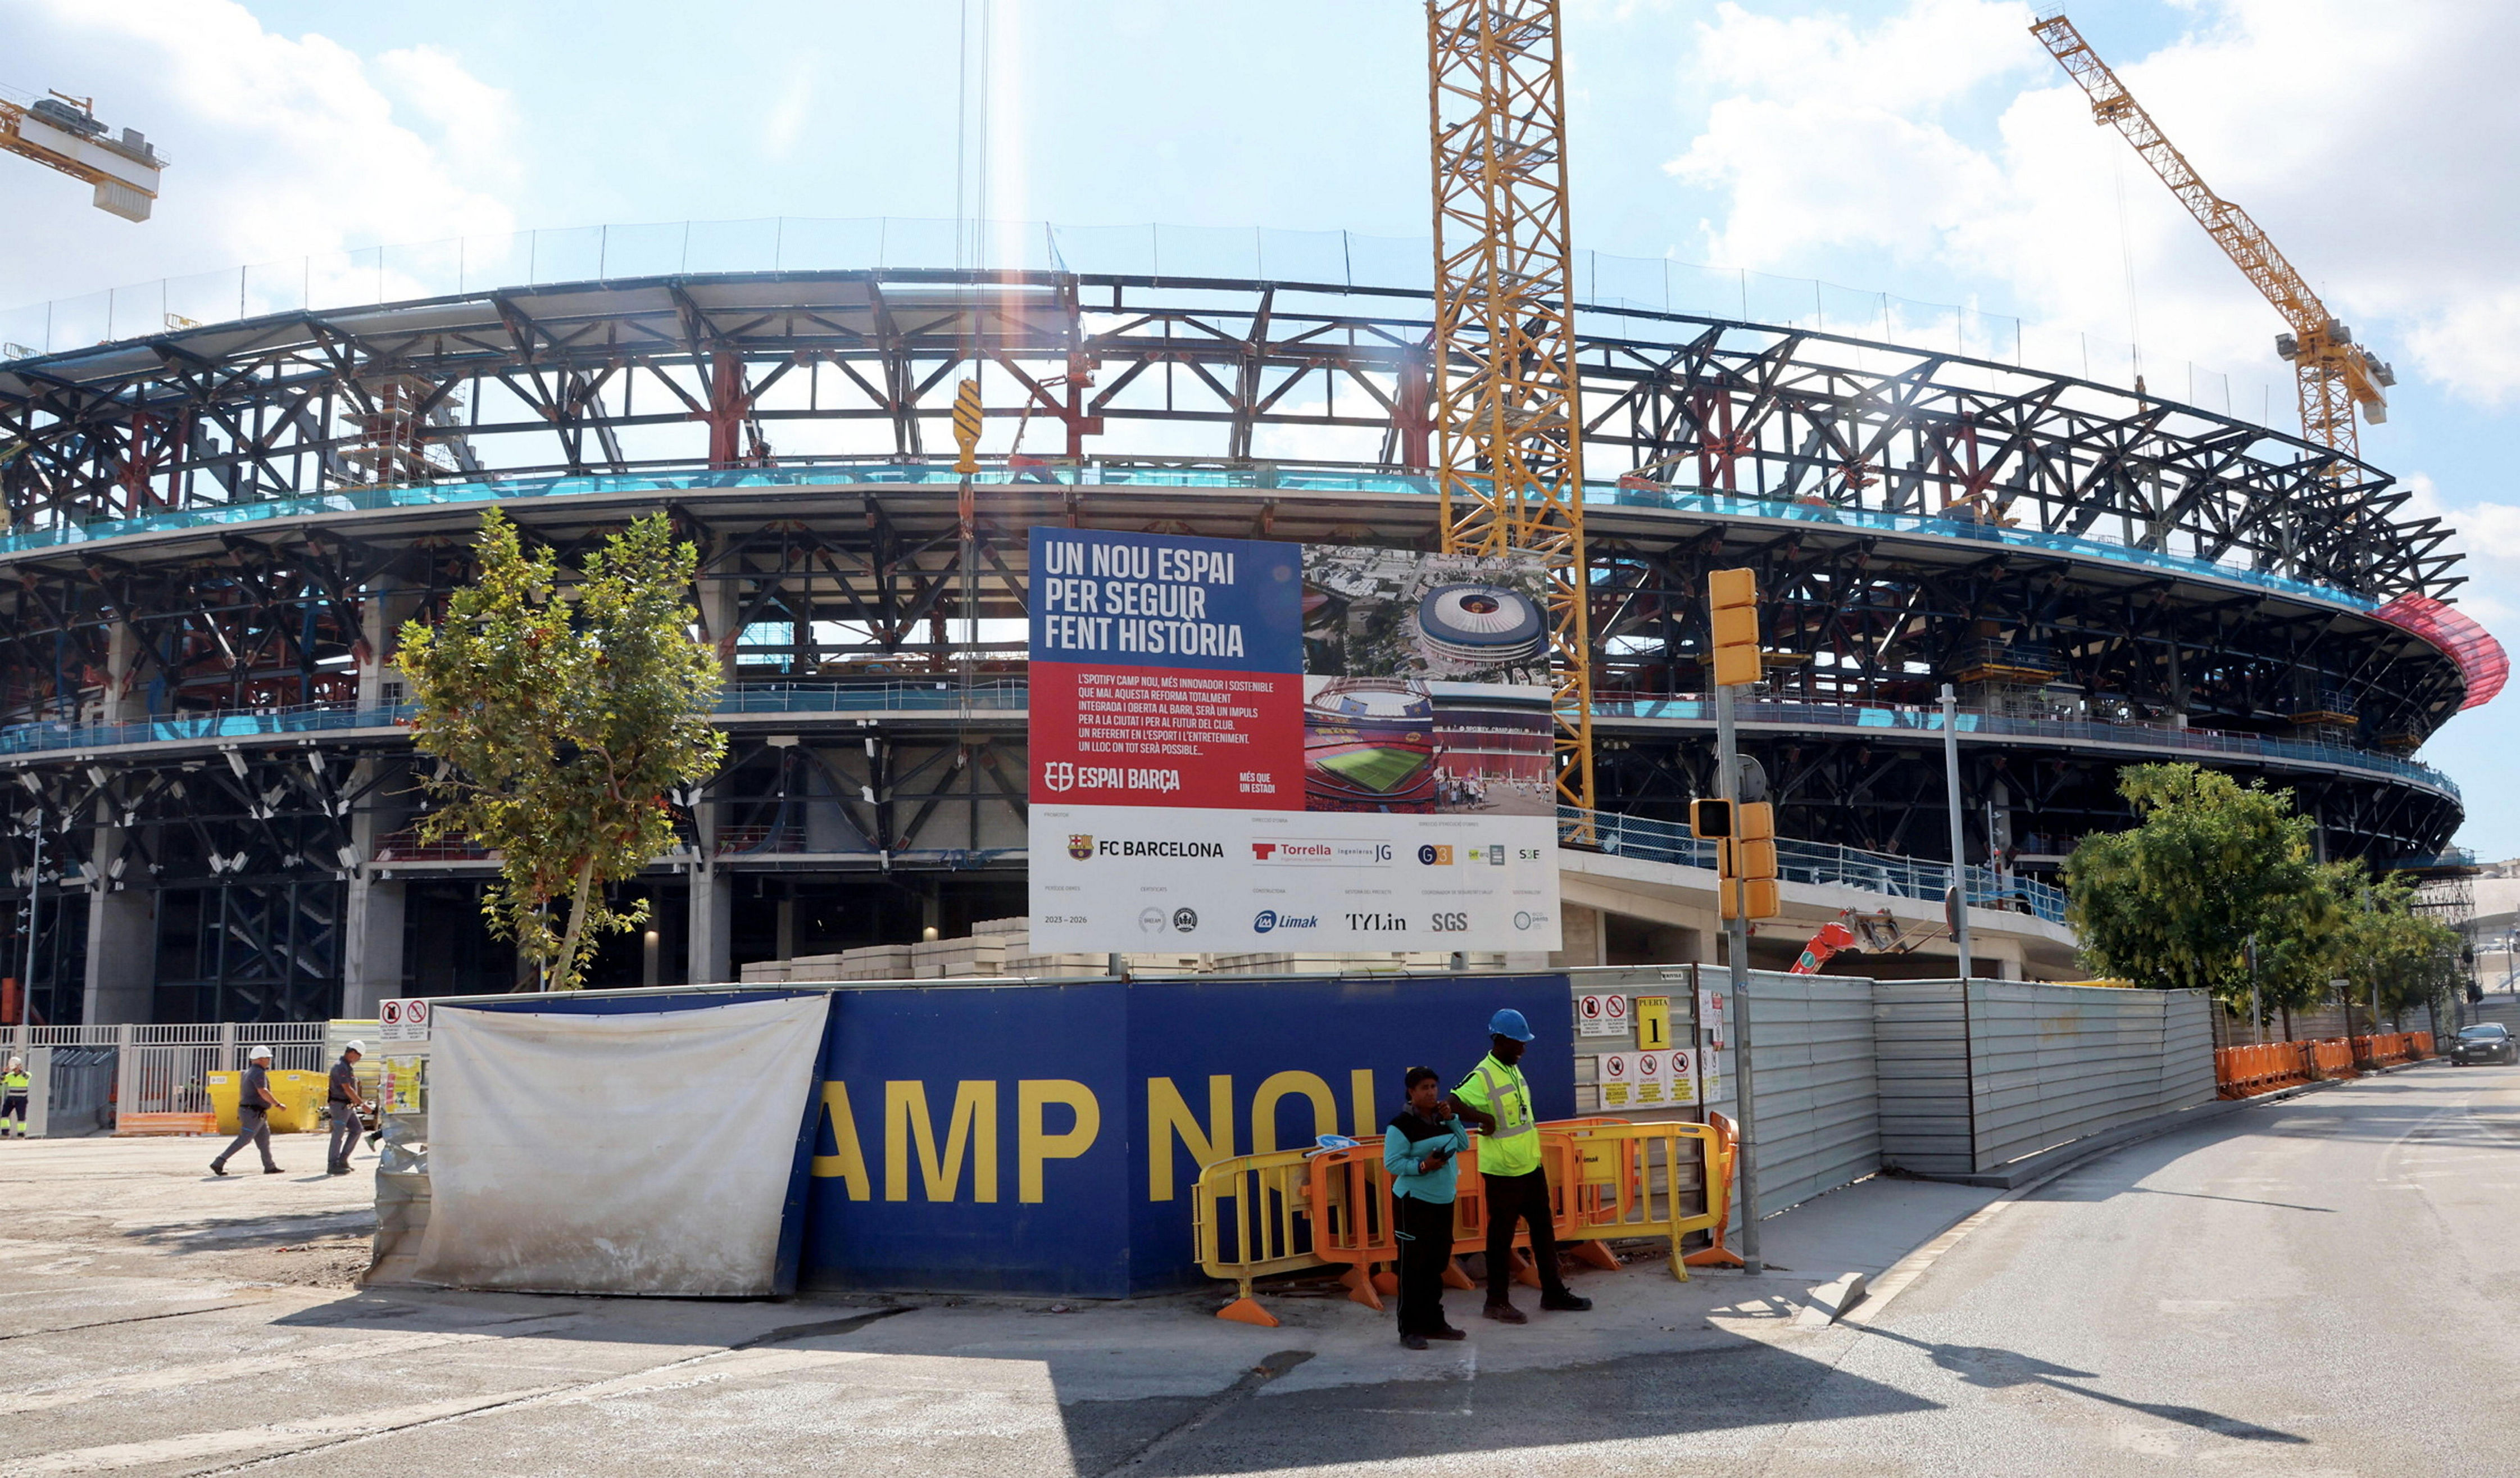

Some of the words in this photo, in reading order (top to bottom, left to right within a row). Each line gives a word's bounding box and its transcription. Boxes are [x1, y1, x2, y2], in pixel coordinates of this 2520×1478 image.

[1046, 541, 1083, 575] UN
[1092, 544, 1149, 579] NOU
[1157, 548, 1233, 584] ESPAI
[1046, 578, 1098, 613] PER
[1105, 581, 1205, 618] SEGUIR
[1046, 615, 1112, 650] FENT
[1119, 614, 1244, 658] HISTÒRIA
[1117, 676, 1139, 686] CAMP
[1141, 677, 1160, 687] NOU,
[1161, 677, 1178, 687] MÉS
[1180, 679, 1223, 690] INNOVADOR
[1229, 681, 1273, 692] SOSTENIBLE
[1079, 687, 1094, 698] QUE
[1096, 688, 1113, 697] MAI.
[1115, 689, 1150, 700] AQUESTA
[1151, 690, 1187, 700] REFORMA
[1189, 692, 1231, 702] TOTALMENT
[1078, 701, 1122, 711] INTEGRADA
[1124, 702, 1126, 711] I
[1128, 702, 1157, 713] OBERTA
[1159, 704, 1168, 713] AL
[1170, 705, 1195, 715] BARRI,
[1196, 705, 1215, 715] SERÀ
[1217, 706, 1228, 716] UN
[1229, 707, 1257, 718] IMPULS
[1078, 714, 1093, 724] PER
[1095, 715, 1101, 724] A
[1102, 715, 1111, 724] LA
[1113, 715, 1139, 726] CIUTAT
[1146, 717, 1160, 726] PER
[1161, 718, 1170, 727] AL
[1172, 718, 1197, 728] FUTUR
[1198, 719, 1212, 728] DEL
[1214, 720, 1234, 730] CLUB.
[1078, 728, 1090, 737] UN
[1092, 728, 1129, 739] REFERENT
[1131, 730, 1141, 739] EN
[1143, 731, 1177, 741] L'ESPORT
[1179, 732, 1181, 740] I
[1078, 742, 1090, 751] UN
[1092, 742, 1111, 752] LLOC
[1112, 742, 1124, 752] ON
[1125, 743, 1138, 753] TOT
[1140, 743, 1160, 753] SERÀ
[1078, 767, 1123, 788] ESPAI
[1128, 769, 1180, 793] BARÇA
[1239, 772, 1255, 782] MÉS
[1256, 773, 1270, 783] QUE
[1239, 783, 1250, 792] UN
[1251, 784, 1275, 794] ESTADI
[1100, 841, 1119, 855] FC
[1124, 841, 1224, 858] BARCELONA
[1281, 844, 1331, 855] Torrella
[1375, 844, 1392, 863] JG
[1279, 915, 1318, 928] Limak
[1346, 913, 1406, 931] TYLin
[1432, 912, 1468, 932] SGS
[1649, 1018, 1662, 1044] 1
[1147, 1066, 1418, 1202] NO
